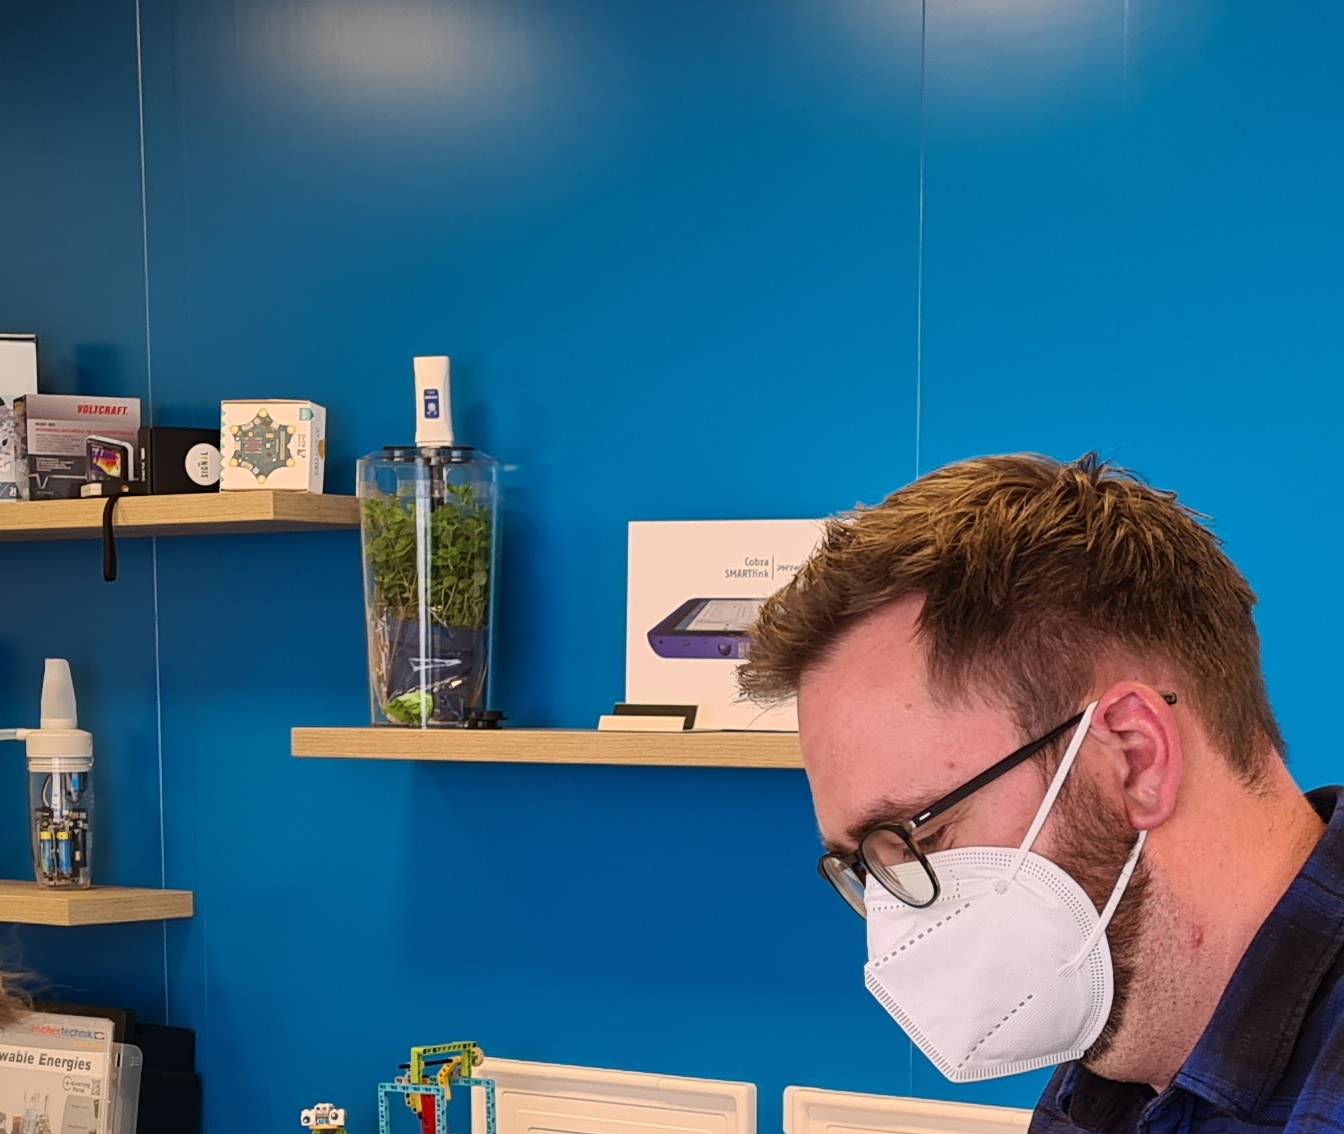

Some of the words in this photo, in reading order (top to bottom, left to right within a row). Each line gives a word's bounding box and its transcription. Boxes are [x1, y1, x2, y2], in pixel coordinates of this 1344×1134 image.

[77, 405, 128, 416] VOLTCRAFT
[744, 556, 769, 567] Cobra
[724, 568, 769, 578] SMARTlink
[38, 1053, 92, 1072] Energies
